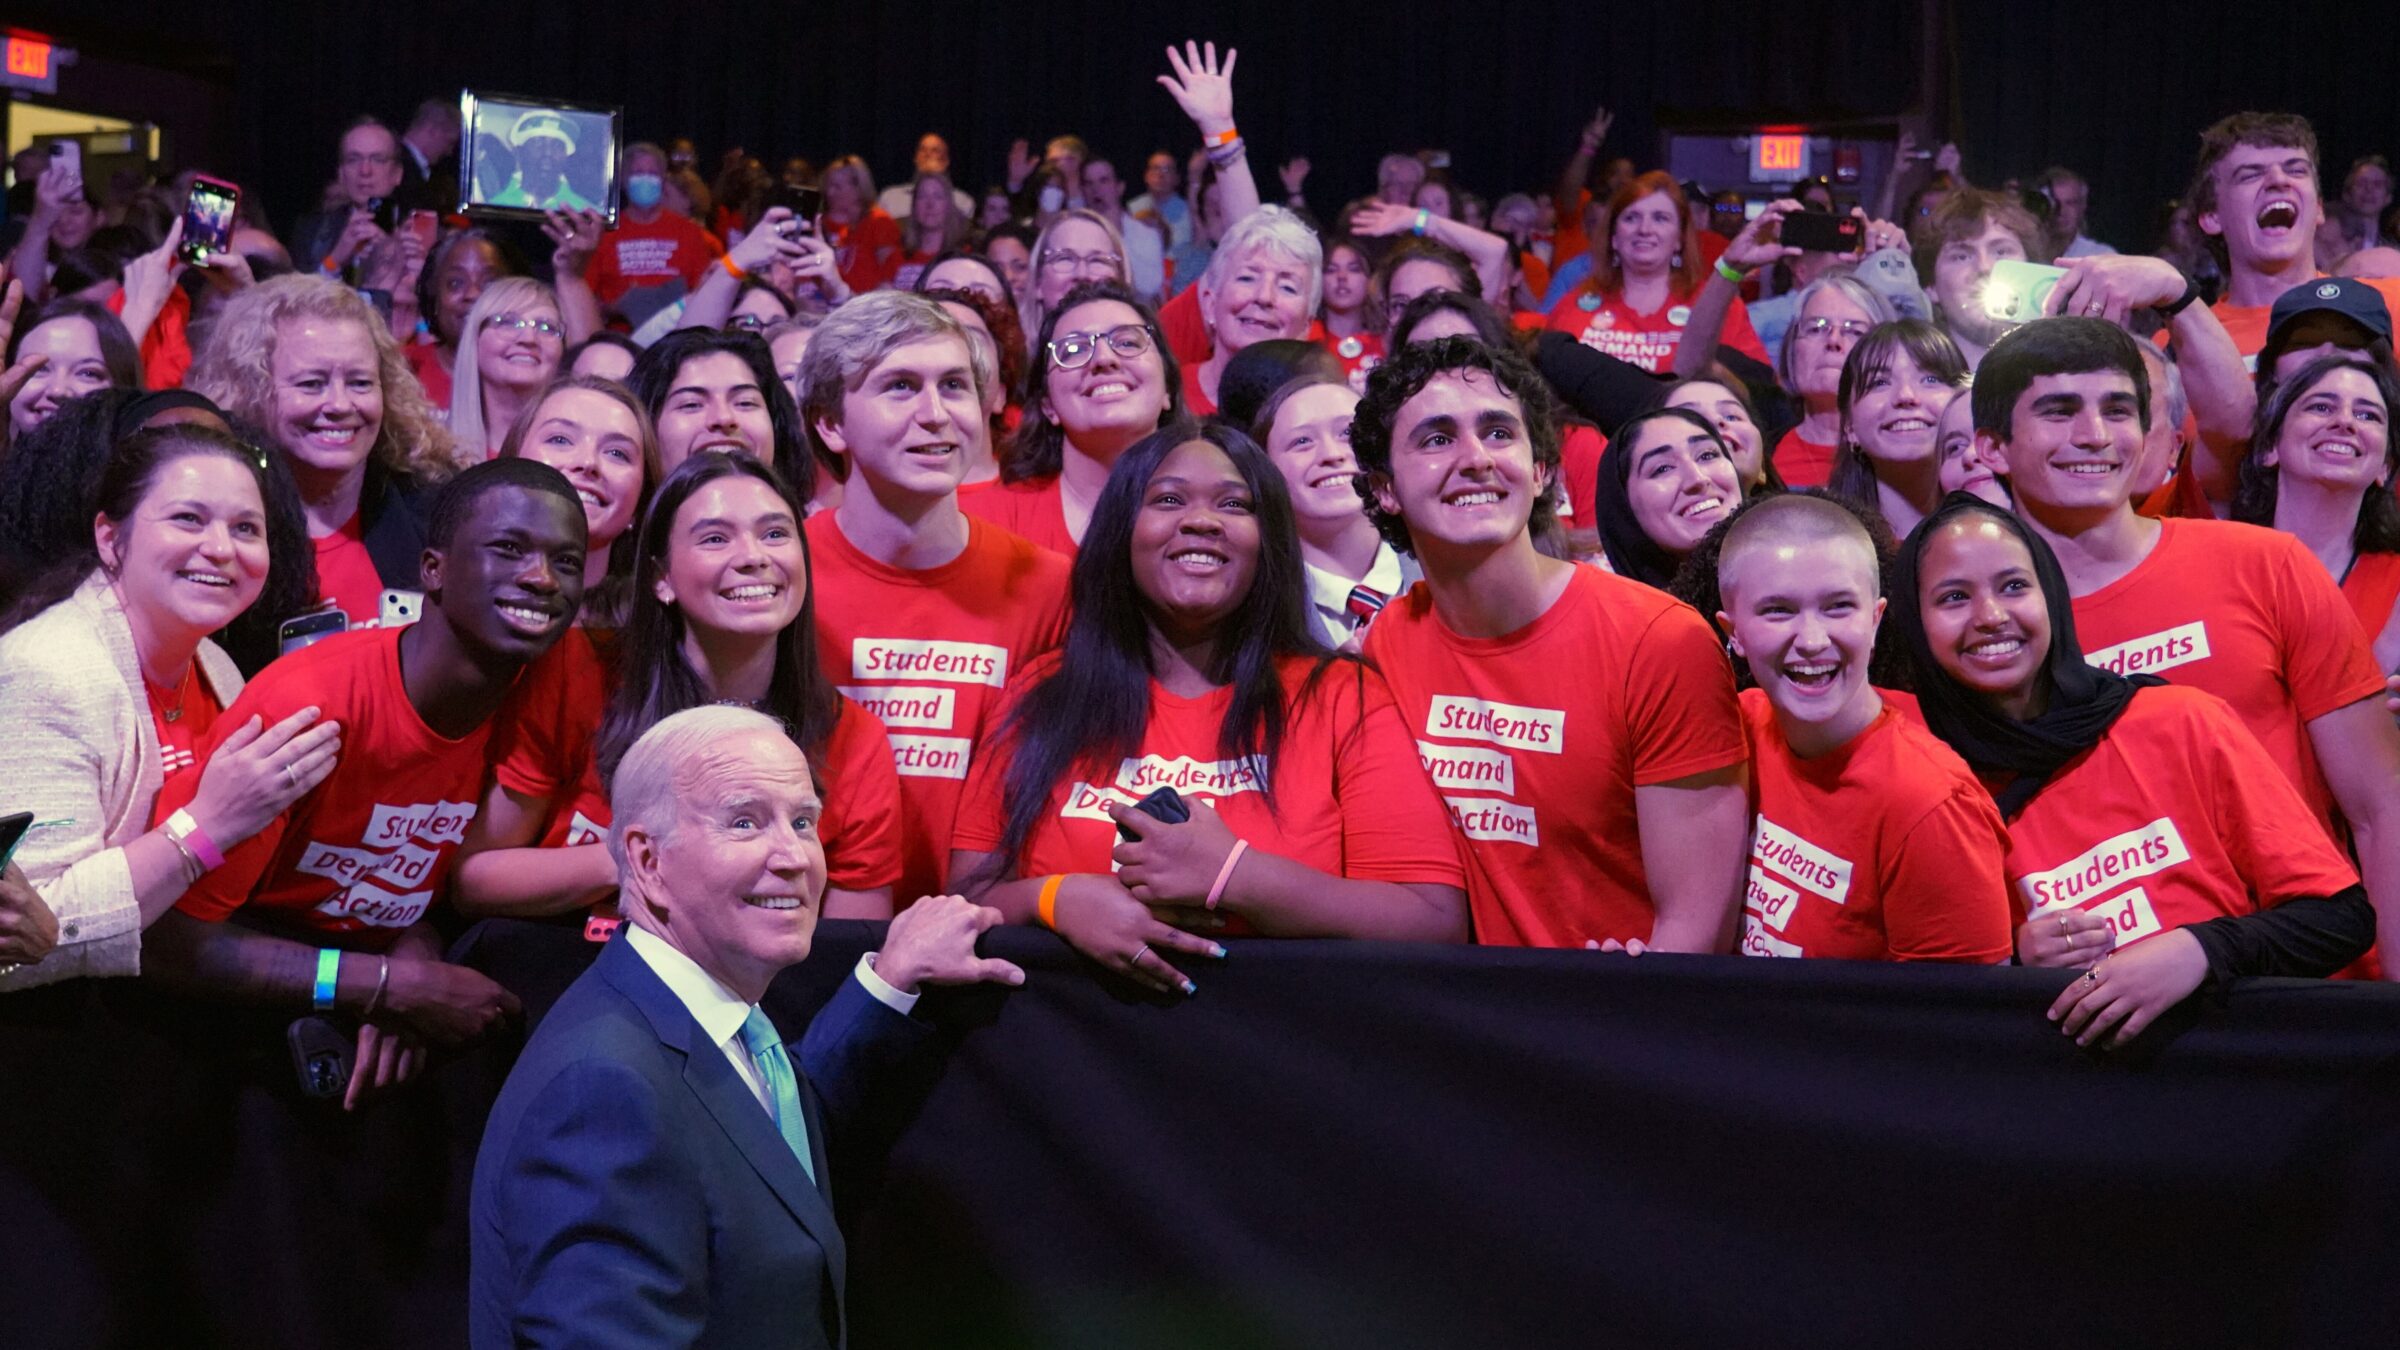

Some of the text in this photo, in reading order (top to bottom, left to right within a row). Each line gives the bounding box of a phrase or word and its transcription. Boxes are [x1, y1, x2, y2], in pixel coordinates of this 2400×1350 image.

[7, 37, 51, 79] EXIT
[1760, 136, 1803, 170] EXIT
[1582, 327, 1647, 343] MOMS
[865, 647, 996, 676] Students
[2099, 636, 2194, 675] dents
[861, 695, 942, 719] mand
[1440, 704, 1552, 743] Students
[893, 743, 960, 770] ction
[1420, 754, 1505, 784] mand
[1131, 762, 1254, 789] Students
[1757, 832, 1839, 889] udents
[2033, 836, 2169, 908] Students
[326, 888, 421, 921] Action
